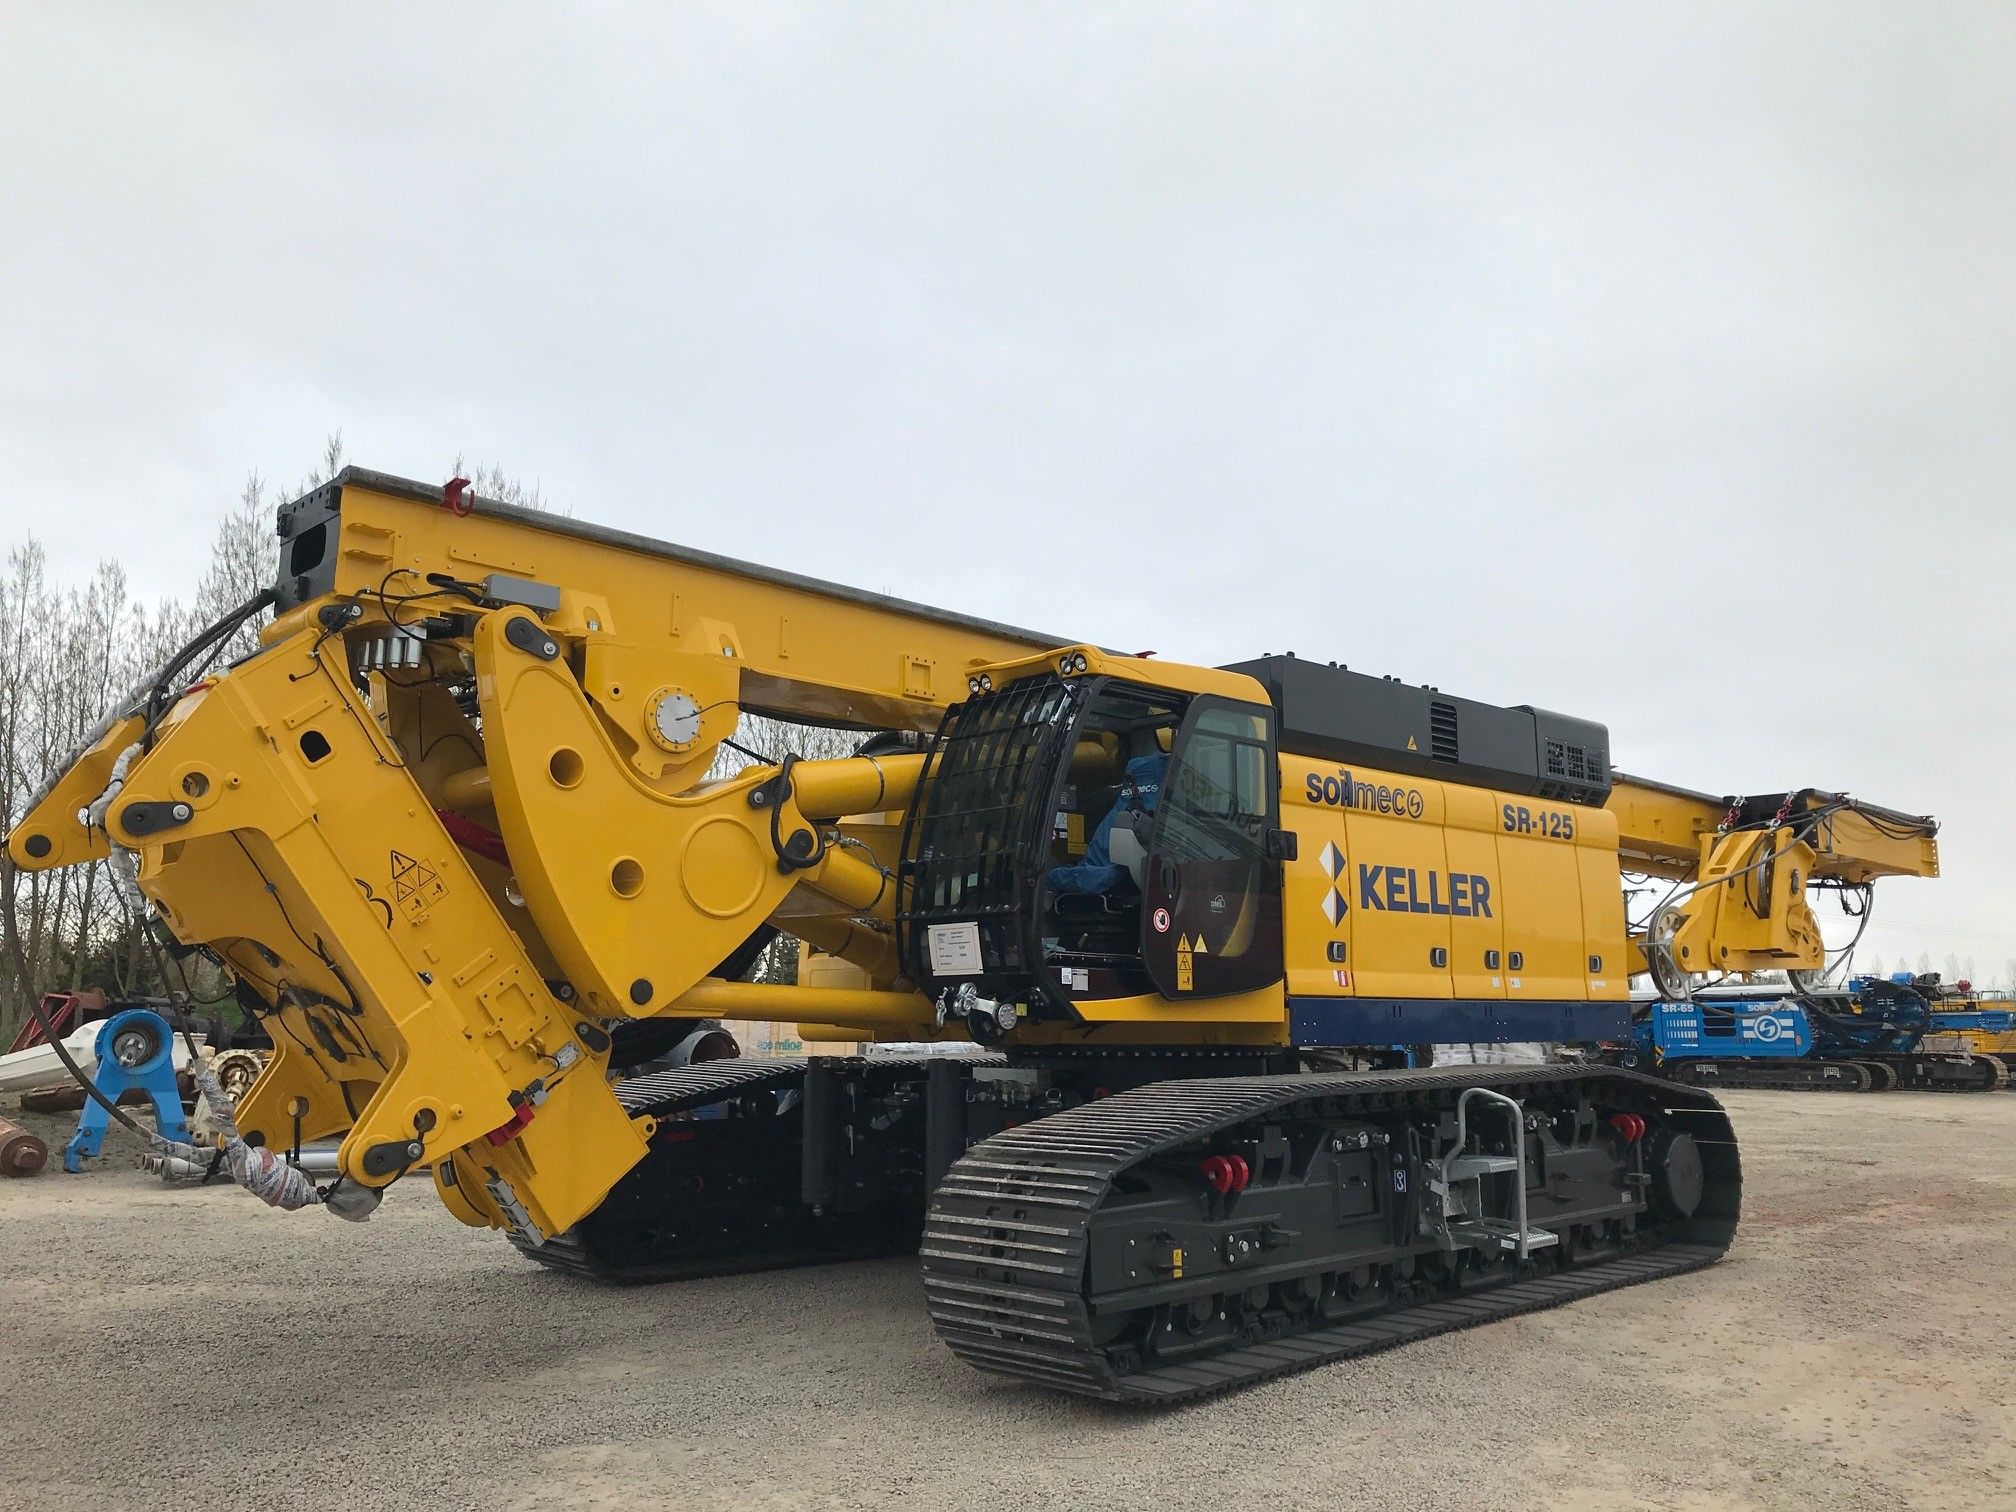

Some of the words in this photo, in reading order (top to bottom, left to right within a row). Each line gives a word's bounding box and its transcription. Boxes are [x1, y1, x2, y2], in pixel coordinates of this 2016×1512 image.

[1306, 769, 1407, 816] soilmec
[1503, 804, 1574, 840] SR-125
[1359, 863, 1493, 918] KELLER
[1661, 1004, 1695, 1013] SR-65
